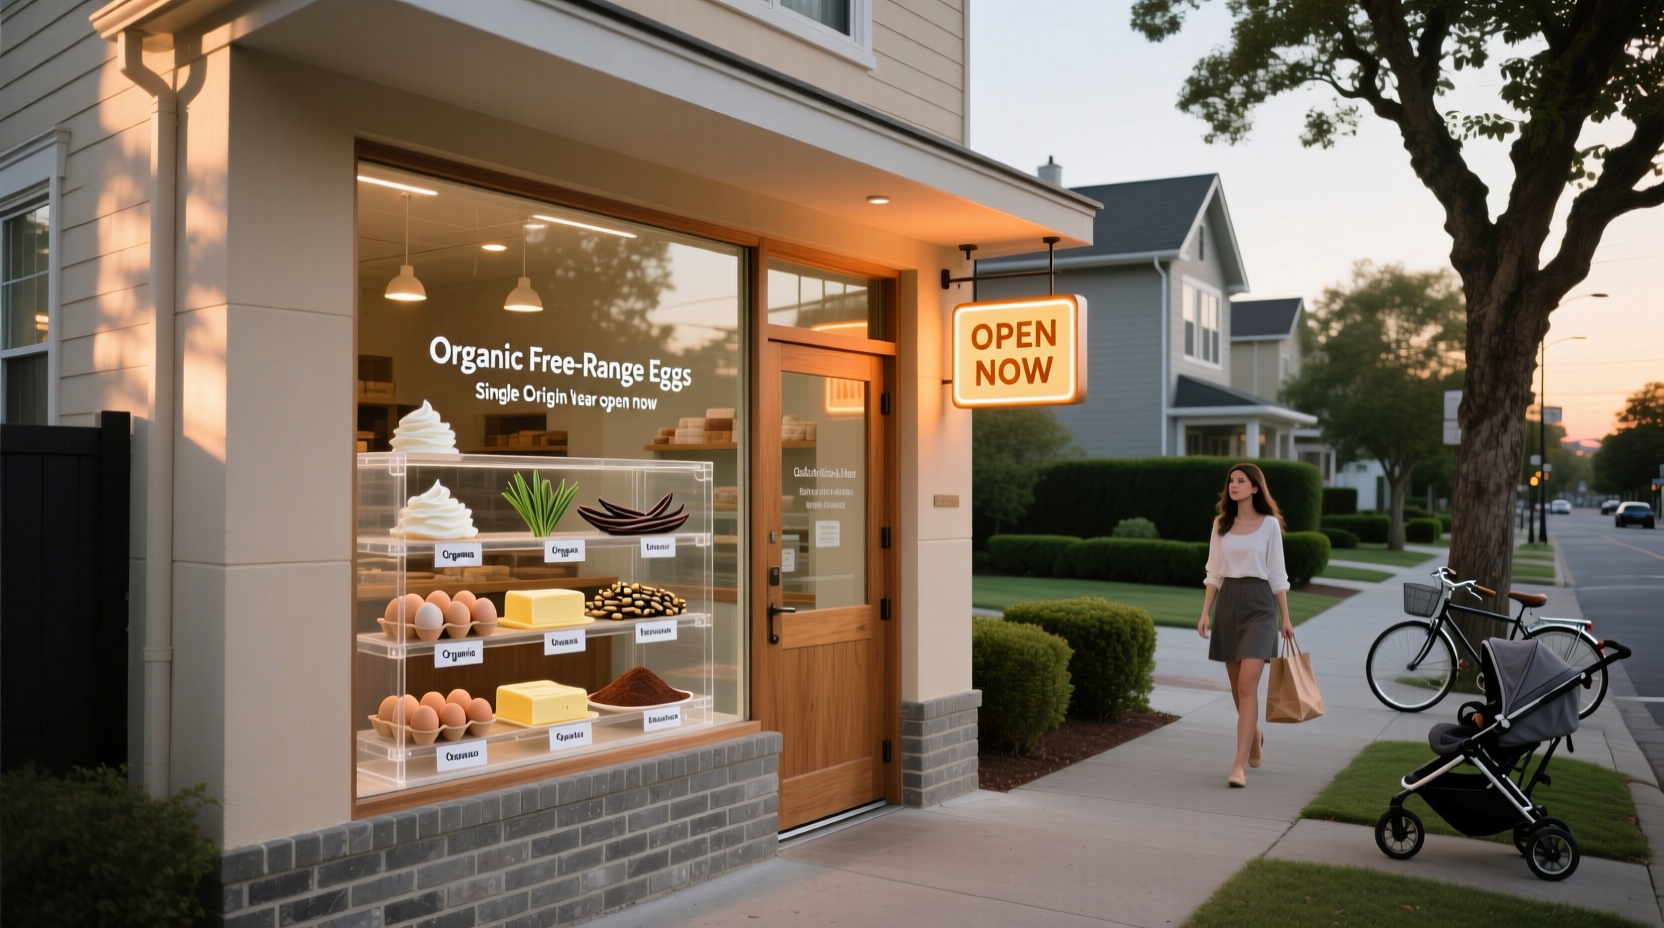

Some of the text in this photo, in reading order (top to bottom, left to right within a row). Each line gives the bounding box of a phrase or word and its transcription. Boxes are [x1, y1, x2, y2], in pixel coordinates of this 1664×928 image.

[971, 319, 1057, 351] OPEN
[429, 336, 692, 392] Organic Free-Range Eggs
[975, 356, 1054, 387] NOW
[475, 382, 520, 405] Single
[523, 385, 568, 408] Origin
[600, 395, 630, 413] open
[632, 396, 658, 410] now
